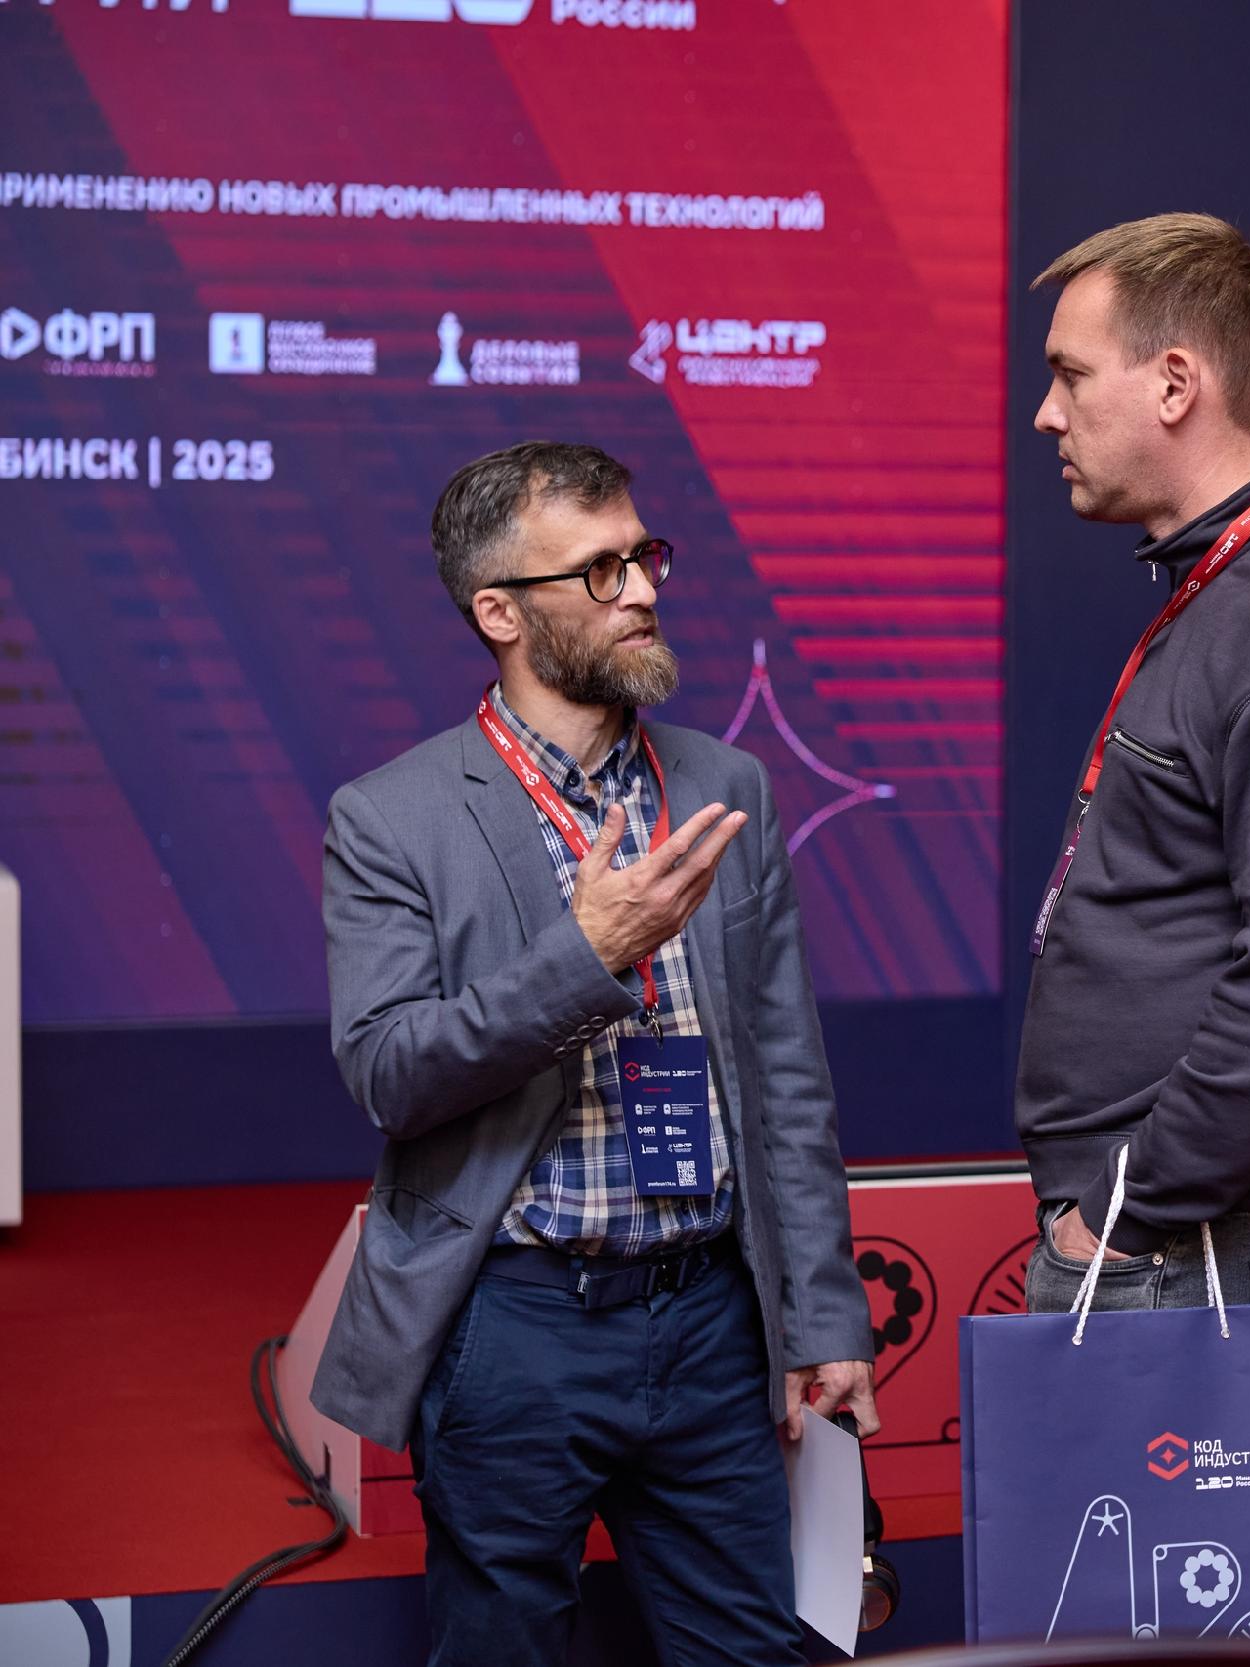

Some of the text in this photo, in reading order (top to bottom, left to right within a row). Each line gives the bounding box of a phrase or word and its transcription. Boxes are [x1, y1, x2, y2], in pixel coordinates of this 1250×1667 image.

[0, 172, 825, 231] РИМЕНЕНИЮ НОВЫХ ПРОМЫШЛЕННЫХ ТЕХНОЛОГИЙ
[44, 308, 156, 362] ФРП
[675, 317, 826, 356] ЦЕНТР
[0, 436, 140, 480] БИНСК
[172, 438, 275, 481] 2025
[1193, 1439, 1223, 1454] КОД
